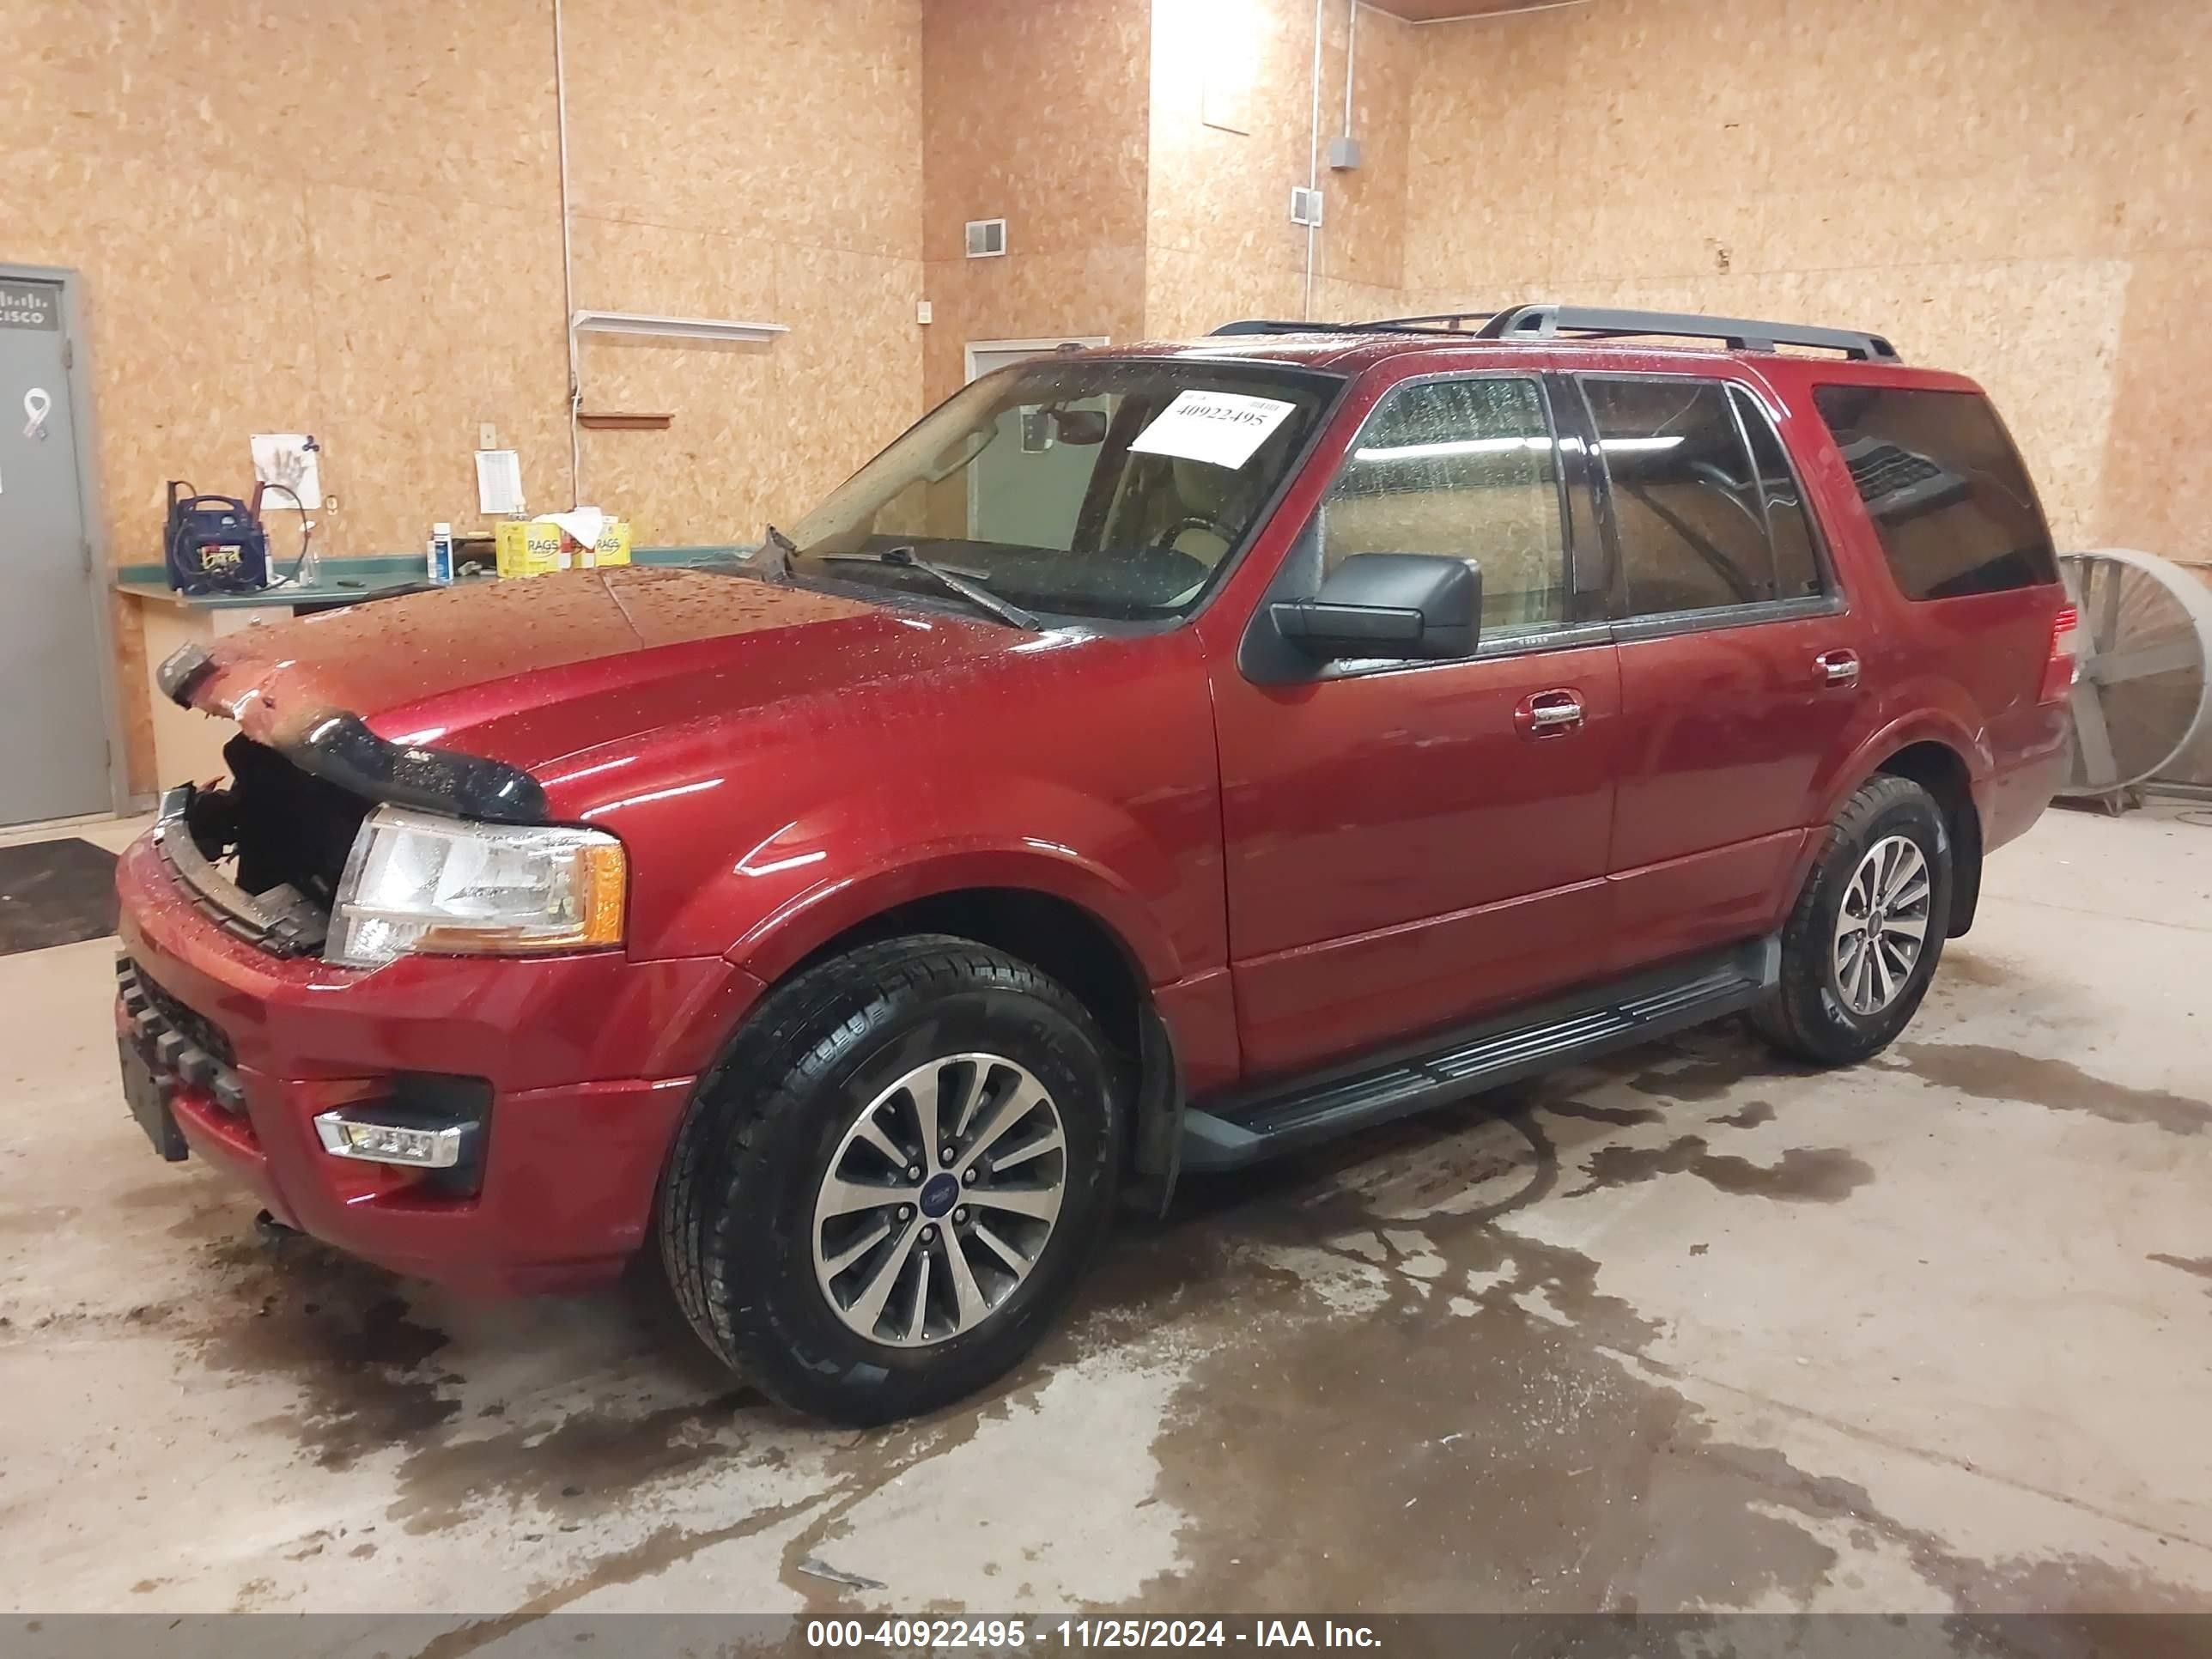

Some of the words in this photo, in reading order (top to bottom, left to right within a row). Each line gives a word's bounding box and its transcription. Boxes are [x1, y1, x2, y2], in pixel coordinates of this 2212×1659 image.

[0, 310, 45, 324] ISCO
[1176, 404, 1268, 427] 40922495
[528, 539, 558, 550] RAGS
[596, 538, 619, 550] RAGS
